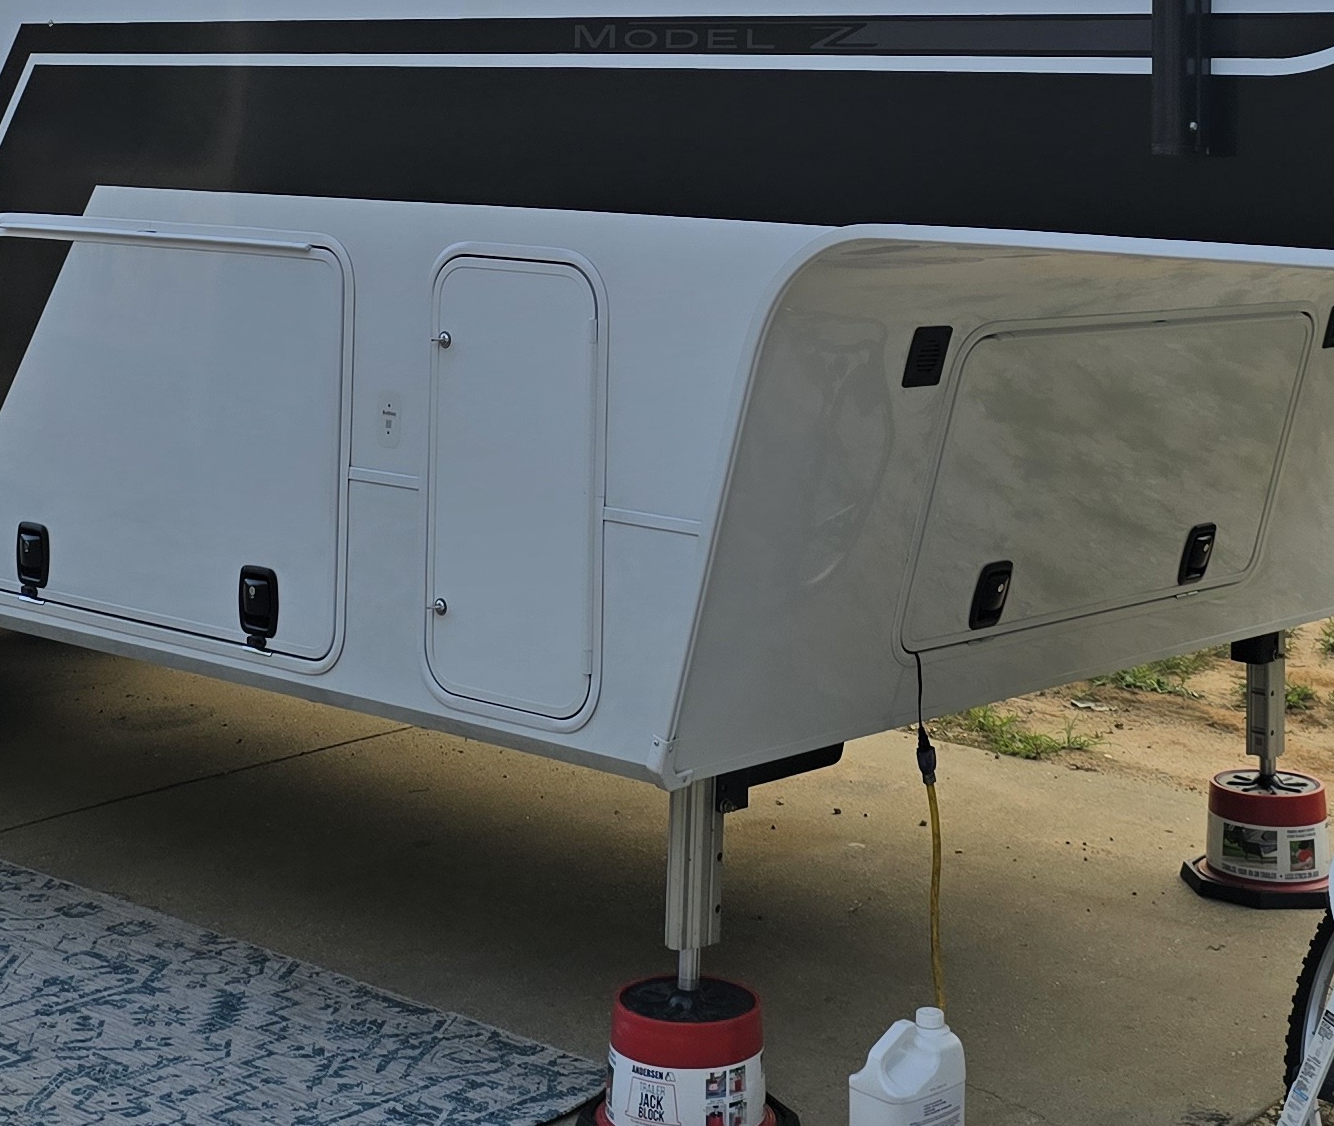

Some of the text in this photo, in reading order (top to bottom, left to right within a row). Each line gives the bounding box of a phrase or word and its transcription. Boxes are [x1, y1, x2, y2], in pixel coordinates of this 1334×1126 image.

[632, 1065, 664, 1080] ANDERSEN
[640, 1082, 666, 1096] TRAILER
[639, 1092, 664, 1110] JACK
[638, 1106, 665, 1123] BLOCK
